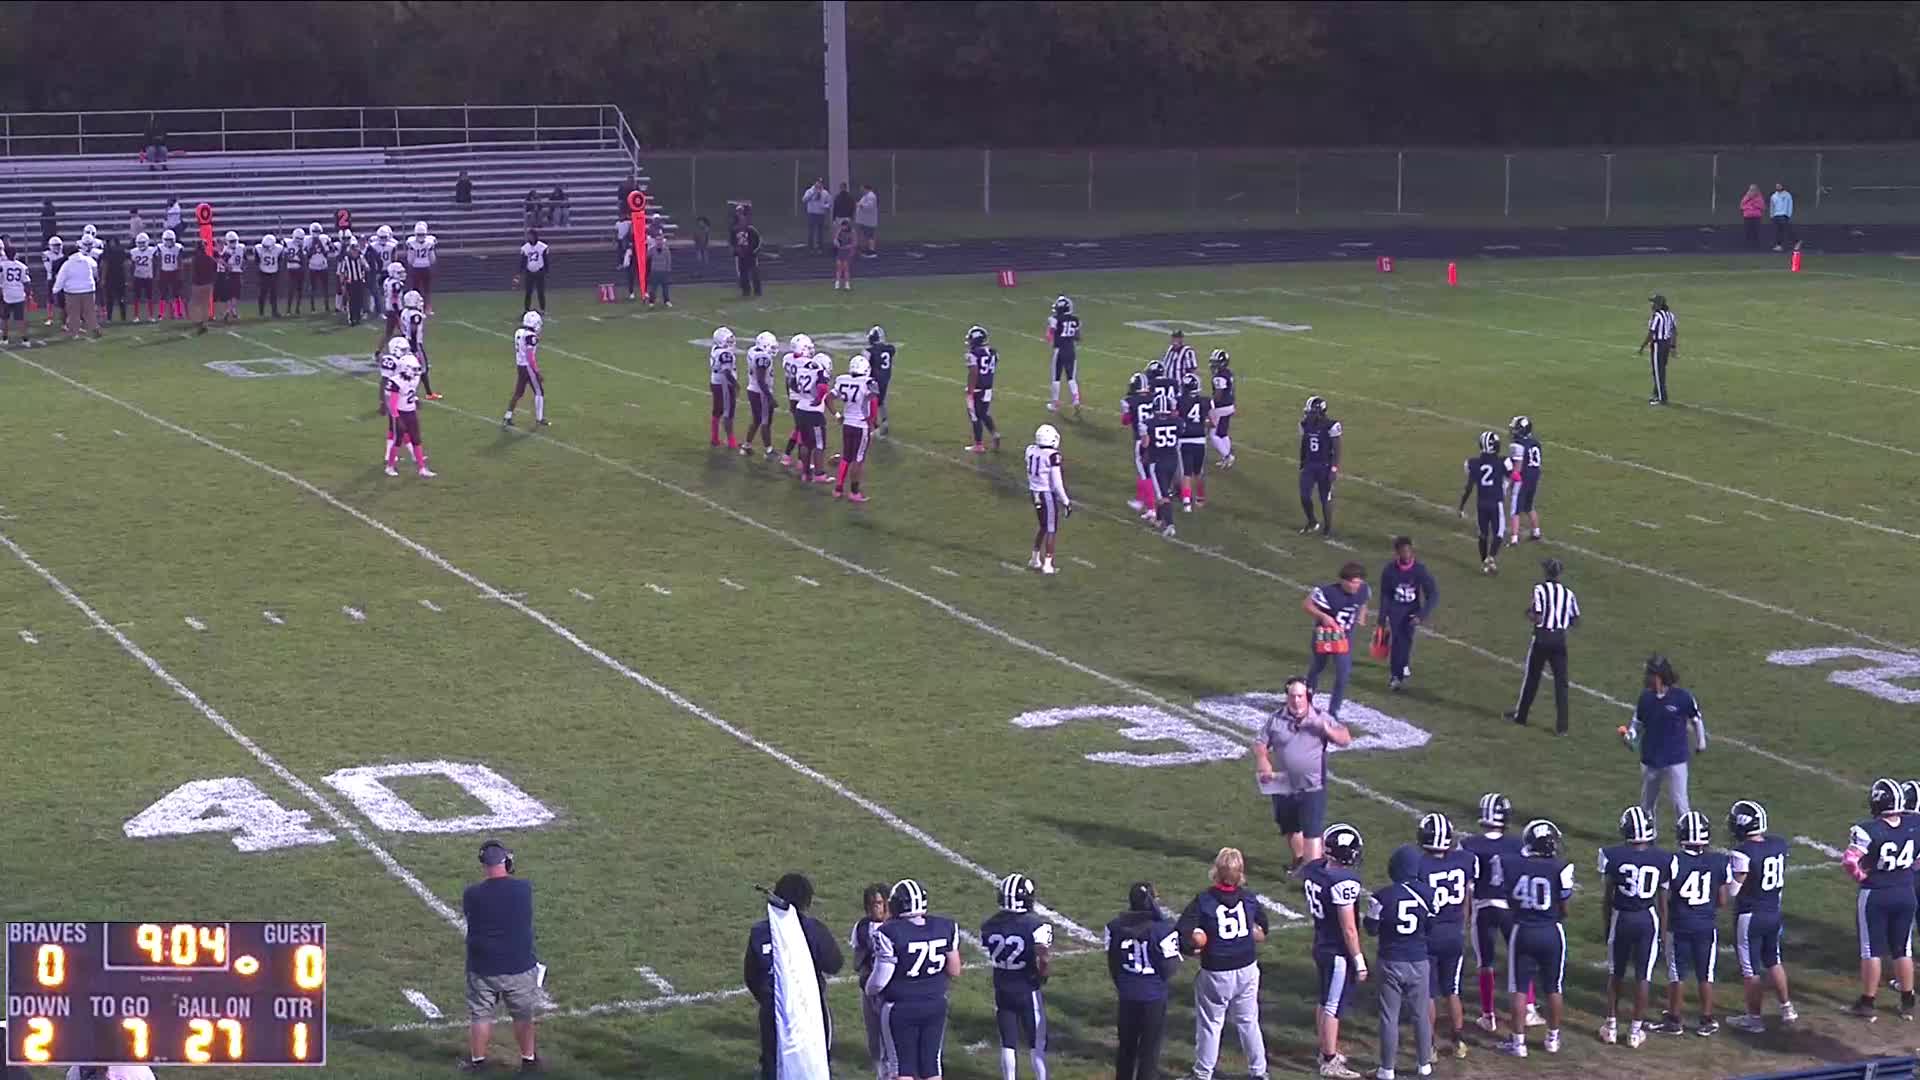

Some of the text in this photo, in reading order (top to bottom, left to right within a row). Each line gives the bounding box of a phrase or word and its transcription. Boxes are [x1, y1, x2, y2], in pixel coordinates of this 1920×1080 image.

[7, 268, 21, 281] 63
[1061, 321, 1077, 337] 16
[881, 352, 890, 369] 3
[839, 384, 860, 403] 57
[1187, 403, 1201, 422] 4
[1155, 426, 1177, 447] 55
[1310, 437, 1319, 451] 6
[1029, 454, 1041, 476] 11
[1480, 464, 1494, 486] 2
[123, 759, 557, 852] 40
[1762, 853, 1785, 891] 81
[1877, 840, 1914, 871] 64
[1512, 875, 1552, 911] 40
[1618, 863, 1660, 899] 30
[1679, 871, 1711, 906] 41
[1215, 900, 1249, 940] 61
[1396, 899, 1419, 934] 5
[906, 938, 948, 977] 75
[988, 934, 1027, 970] 22
[1120, 938, 1155, 974] 31
